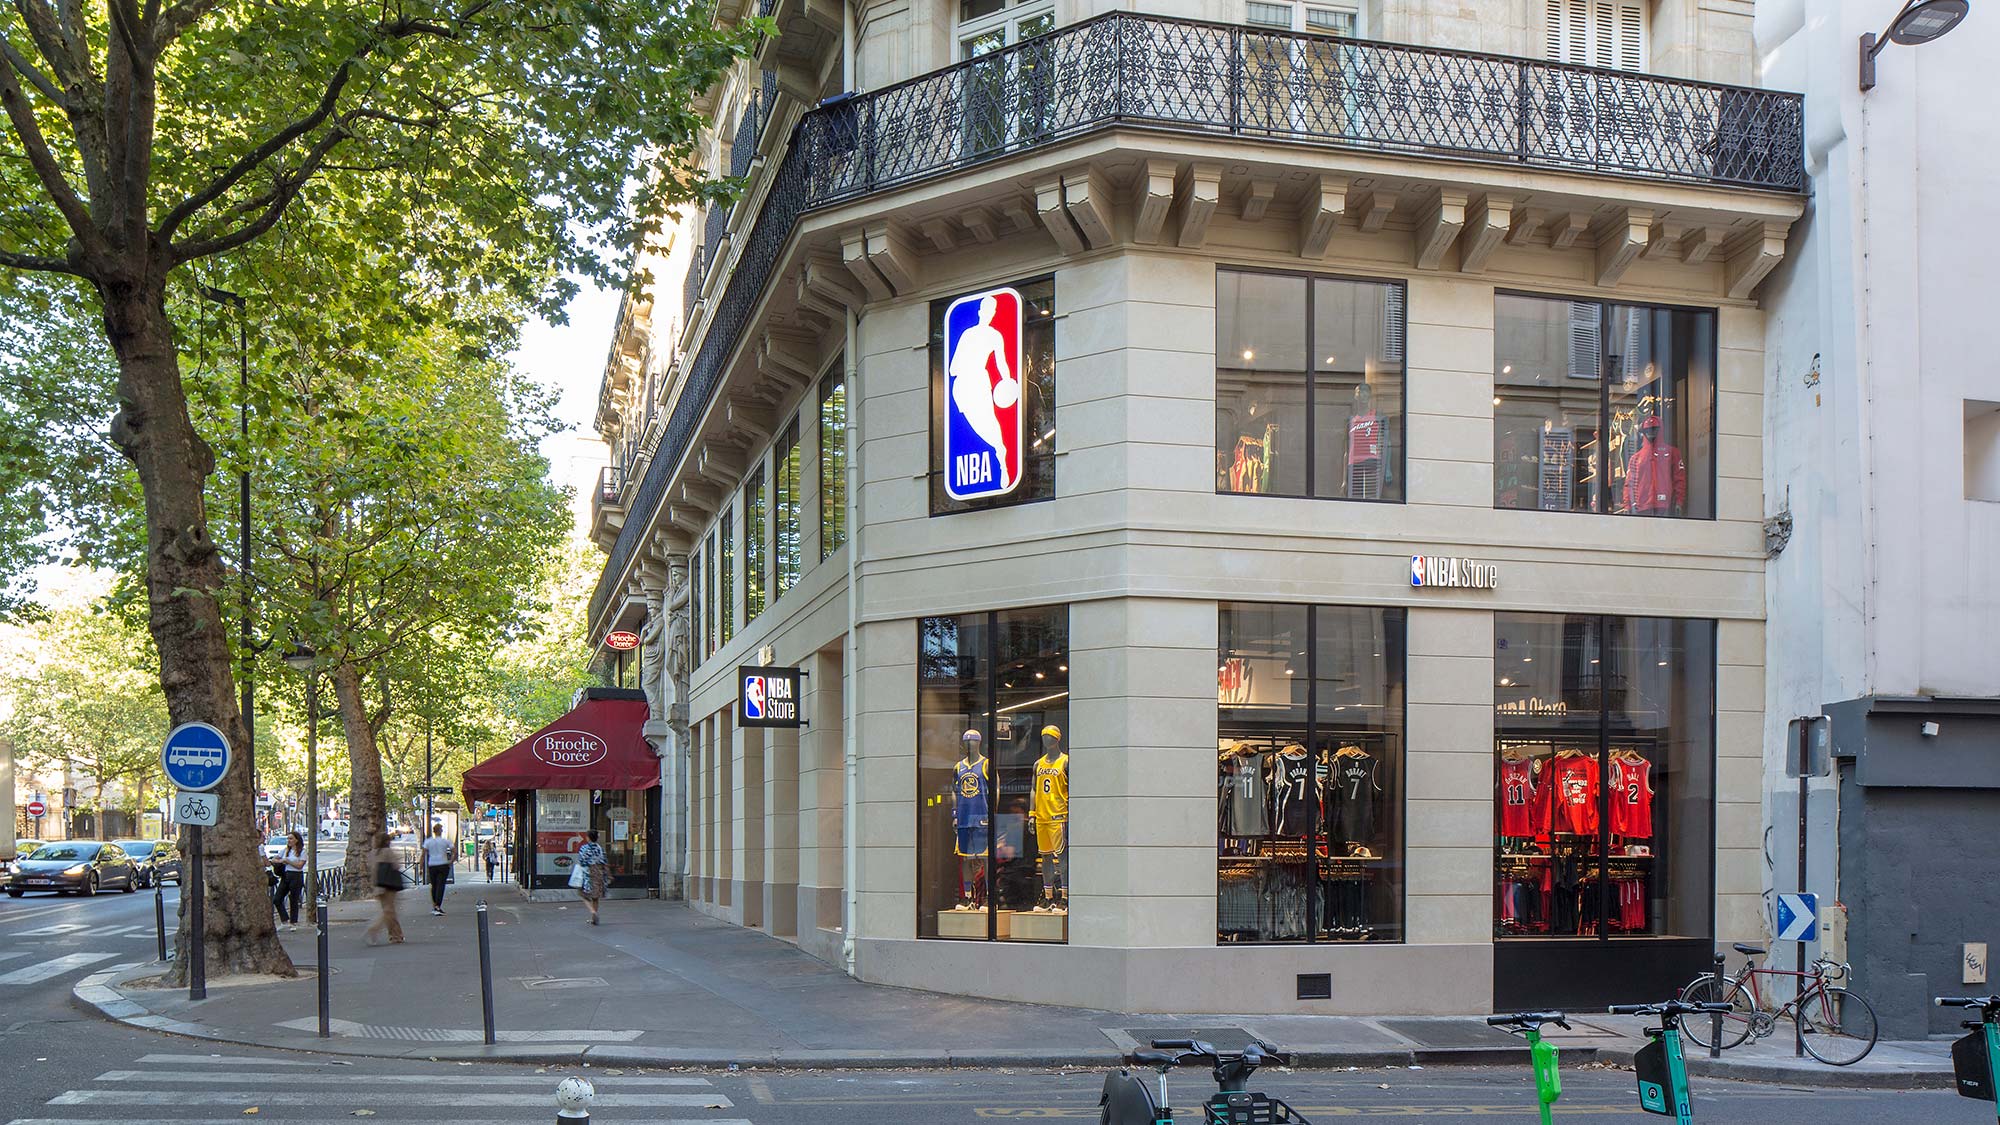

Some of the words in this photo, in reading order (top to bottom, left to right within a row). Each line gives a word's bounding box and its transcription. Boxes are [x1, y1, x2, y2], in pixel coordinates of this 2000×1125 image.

[1365, 427, 1372, 437] 3
[956, 451, 992, 487] NBA
[1426, 556, 1459, 587] NBA
[1461, 558, 1498, 588] Store
[767, 677, 792, 699] NBA
[767, 698, 795, 719] Store
[545, 736, 598, 751] Brioche
[552, 749, 591, 762] Dorée
[1043, 778, 1051, 793] 6
[1242, 776, 1253, 798] 11
[1295, 778, 1305, 800] 7
[1350, 778, 1360, 800] 7
[1508, 784, 1525, 805] 11
[1627, 783, 1638, 805] 2
